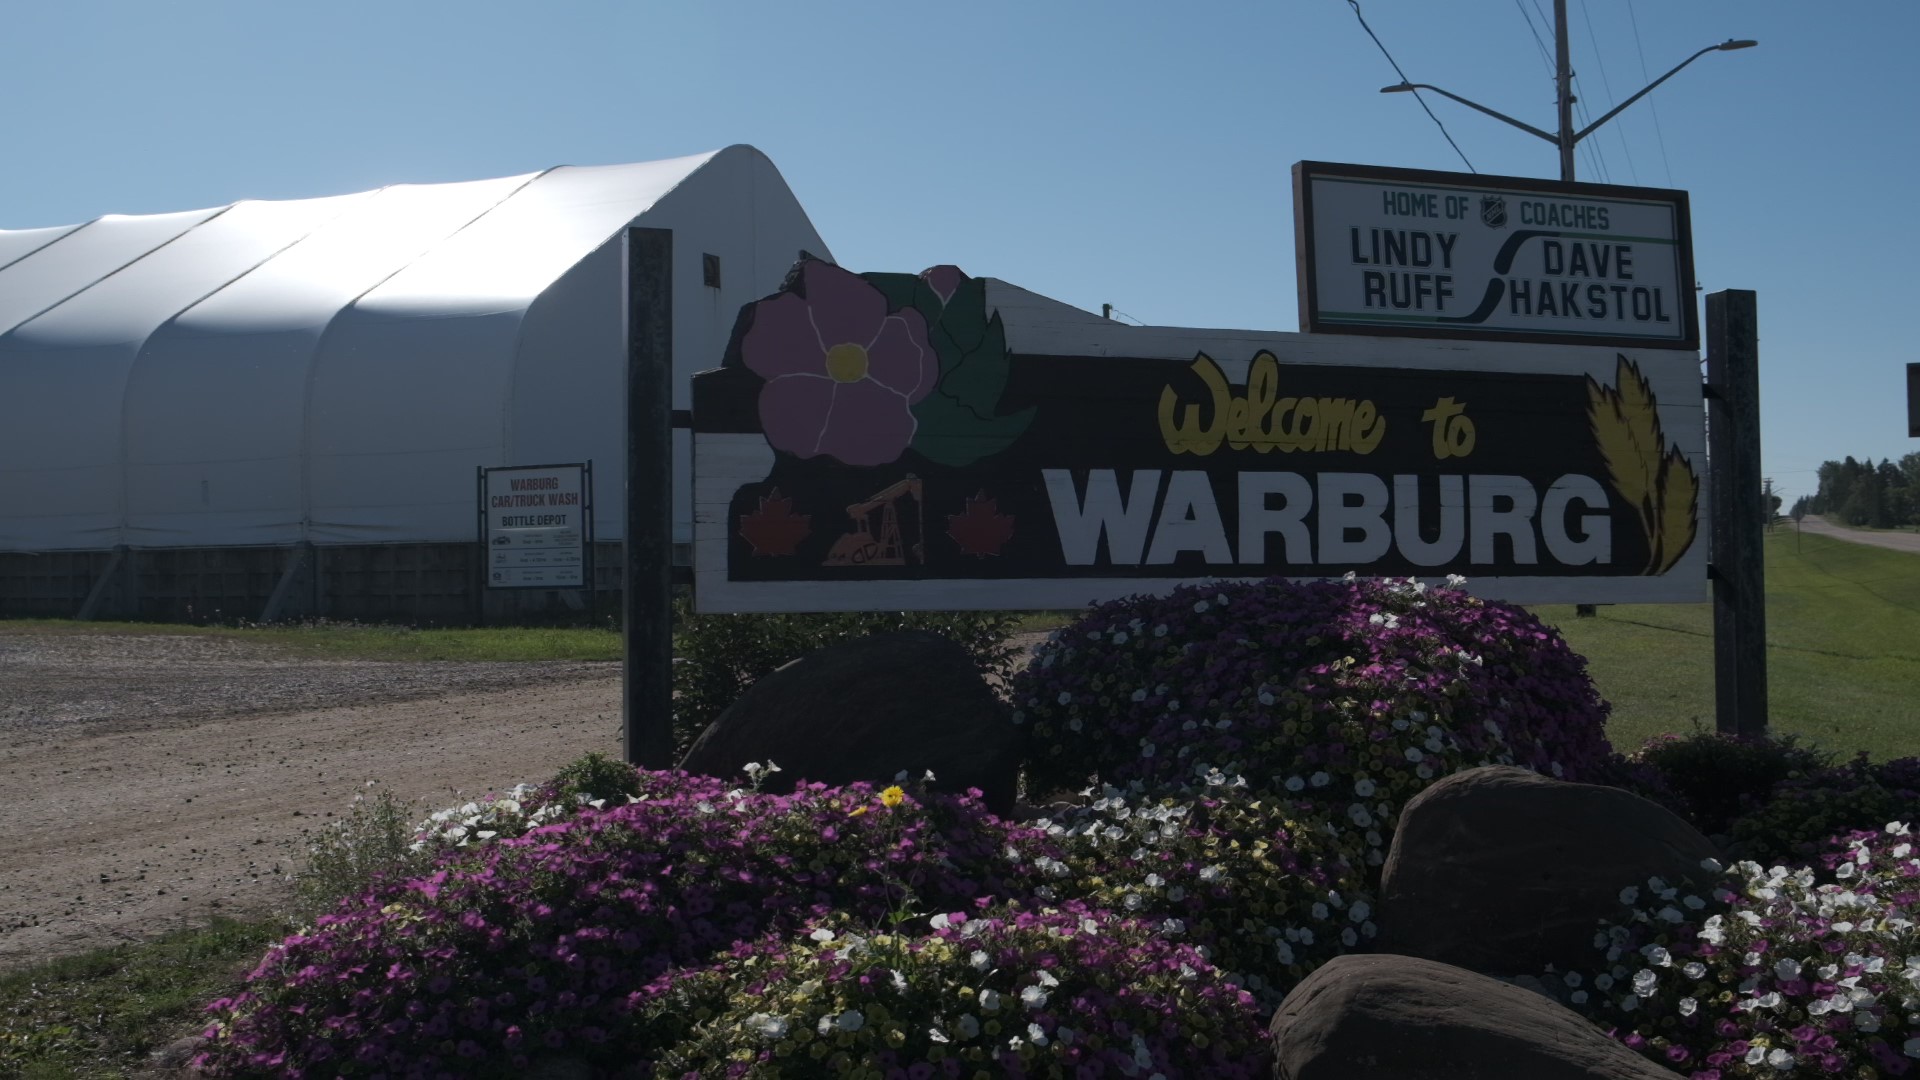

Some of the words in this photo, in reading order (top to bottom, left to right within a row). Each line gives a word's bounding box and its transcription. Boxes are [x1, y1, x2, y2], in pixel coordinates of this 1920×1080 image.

[1383, 190, 1438, 219] HOME
[1446, 195, 1469, 220] OF
[1520, 201, 1610, 230] COACHES
[1350, 225, 1459, 269] LINDY
[1543, 240, 1634, 280] DAVE
[1363, 270, 1455, 311] RUFF
[1509, 278, 1671, 323] HAKSTOL
[1157, 350, 1386, 456] Welcome
[1422, 396, 1476, 460] to
[491, 494, 546, 508] CAR/TRUCK
[548, 492, 579, 506] WASH
[510, 477, 559, 491] WARBURG
[502, 515, 535, 527] BOTTLE
[537, 514, 567, 526] DEPOT
[1041, 468, 1612, 566] WARBURG
